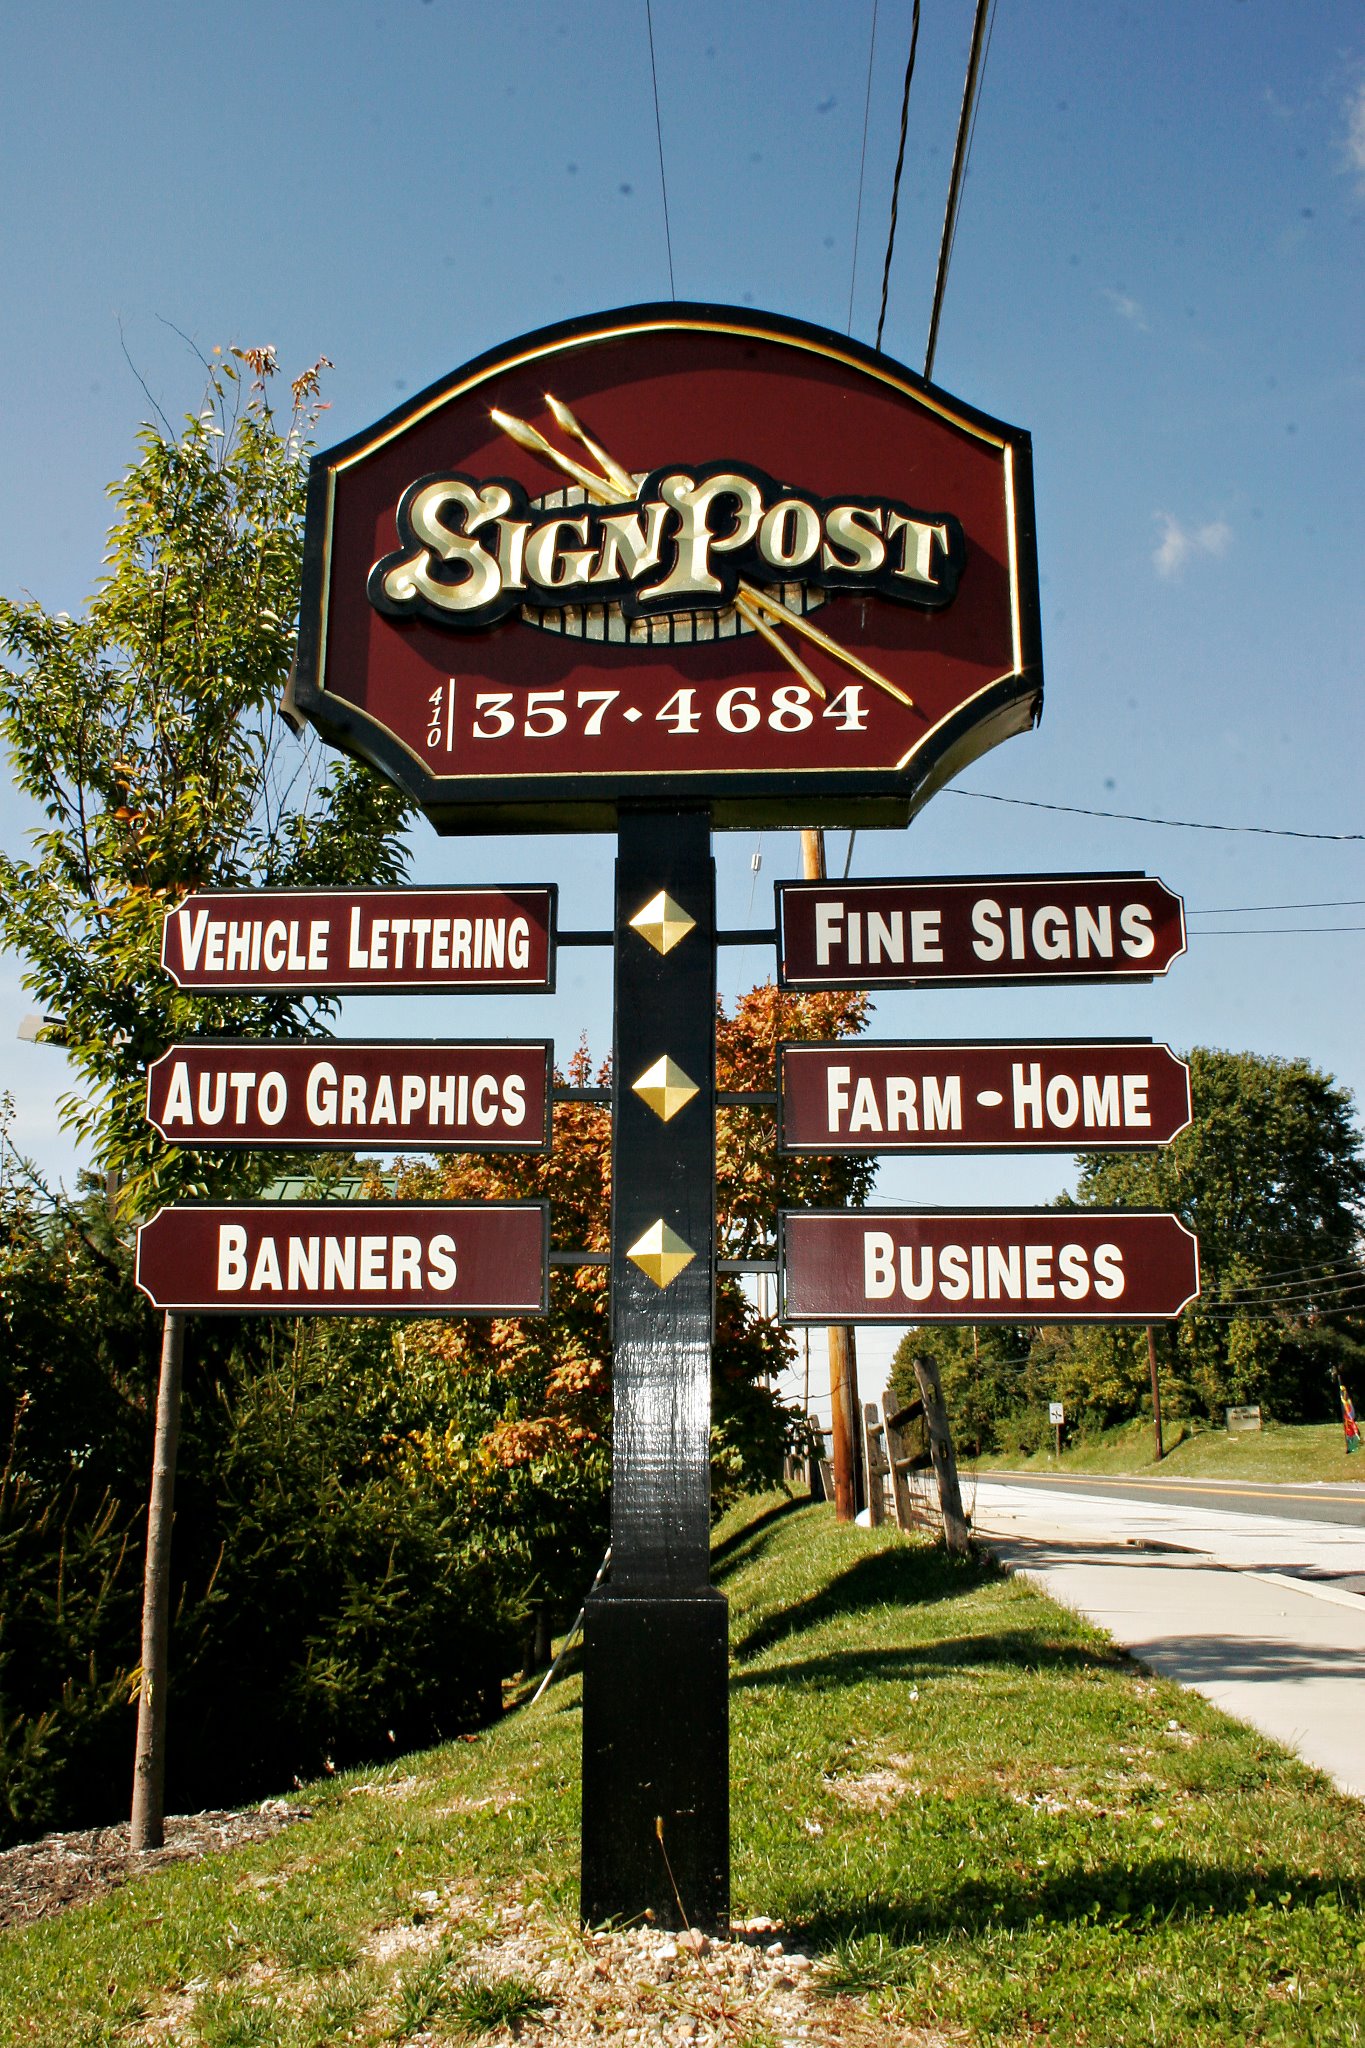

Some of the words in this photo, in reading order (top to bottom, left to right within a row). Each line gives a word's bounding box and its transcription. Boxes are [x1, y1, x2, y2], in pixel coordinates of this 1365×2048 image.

[178, 909, 330, 971] VEHICLE
[348, 906, 530, 970] LETTERING
[815, 902, 944, 966] FINE
[971, 899, 1155, 962] SIGNS
[162, 1061, 288, 1126] AUTO
[305, 1061, 527, 1127] GRAPHICS
[217, 1224, 457, 1291] BANNERS
[864, 1231, 1126, 1300] BUSINESS
